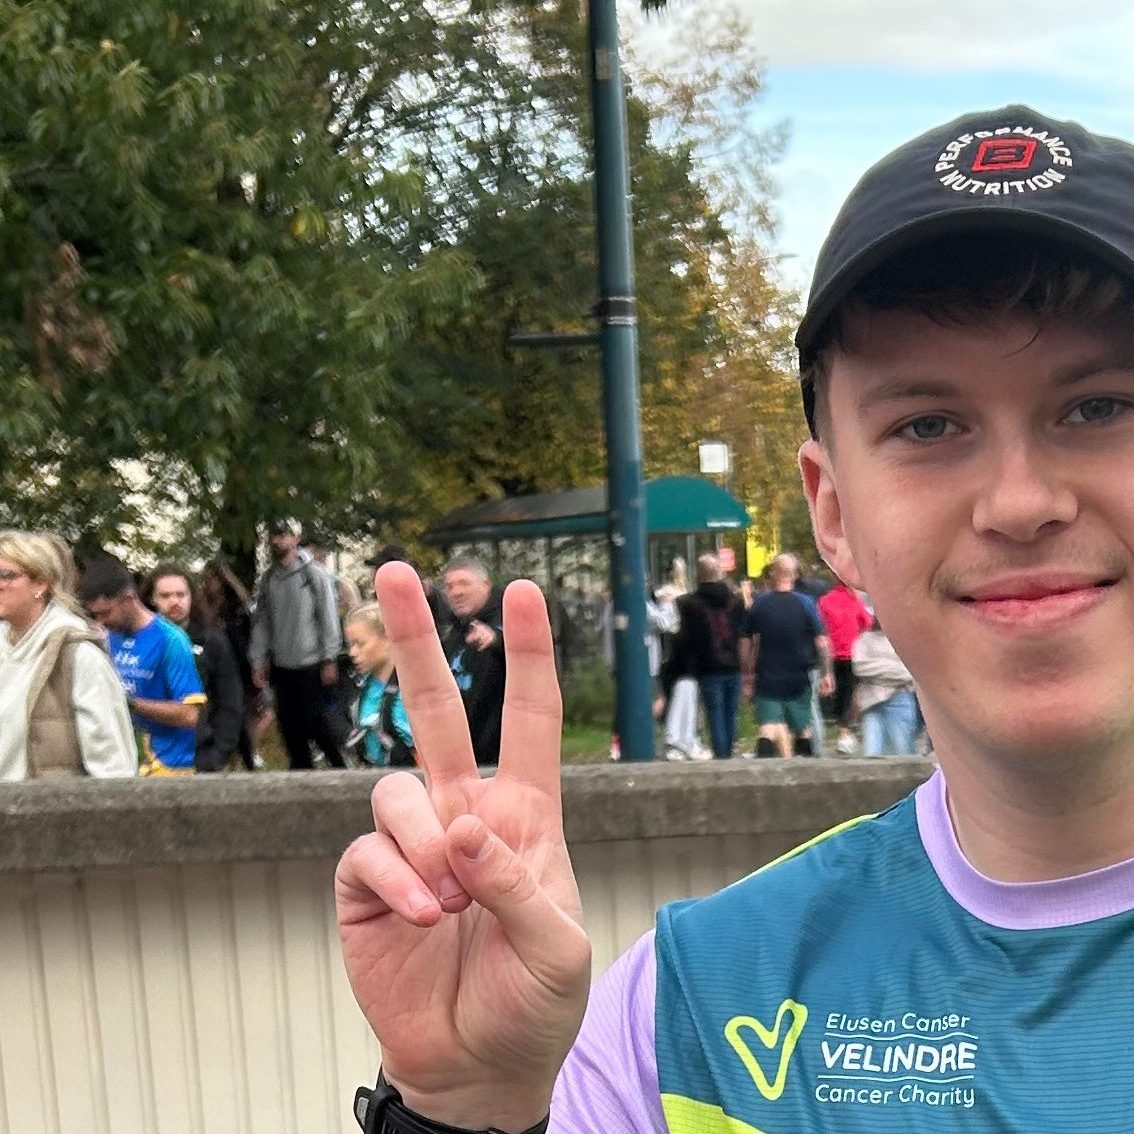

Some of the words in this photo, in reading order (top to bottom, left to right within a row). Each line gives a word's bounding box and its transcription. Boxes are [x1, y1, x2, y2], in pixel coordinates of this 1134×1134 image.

[935, 126, 1073, 173] PERFORMANCE
[939, 167, 1066, 196] NUTRITION
[825, 1012, 896, 1033] Elusen
[901, 1012, 971, 1032] Canser
[821, 1041, 978, 1074] VELINDRE
[815, 1084, 893, 1105] Cancer
[898, 1084, 975, 1109] Charity
